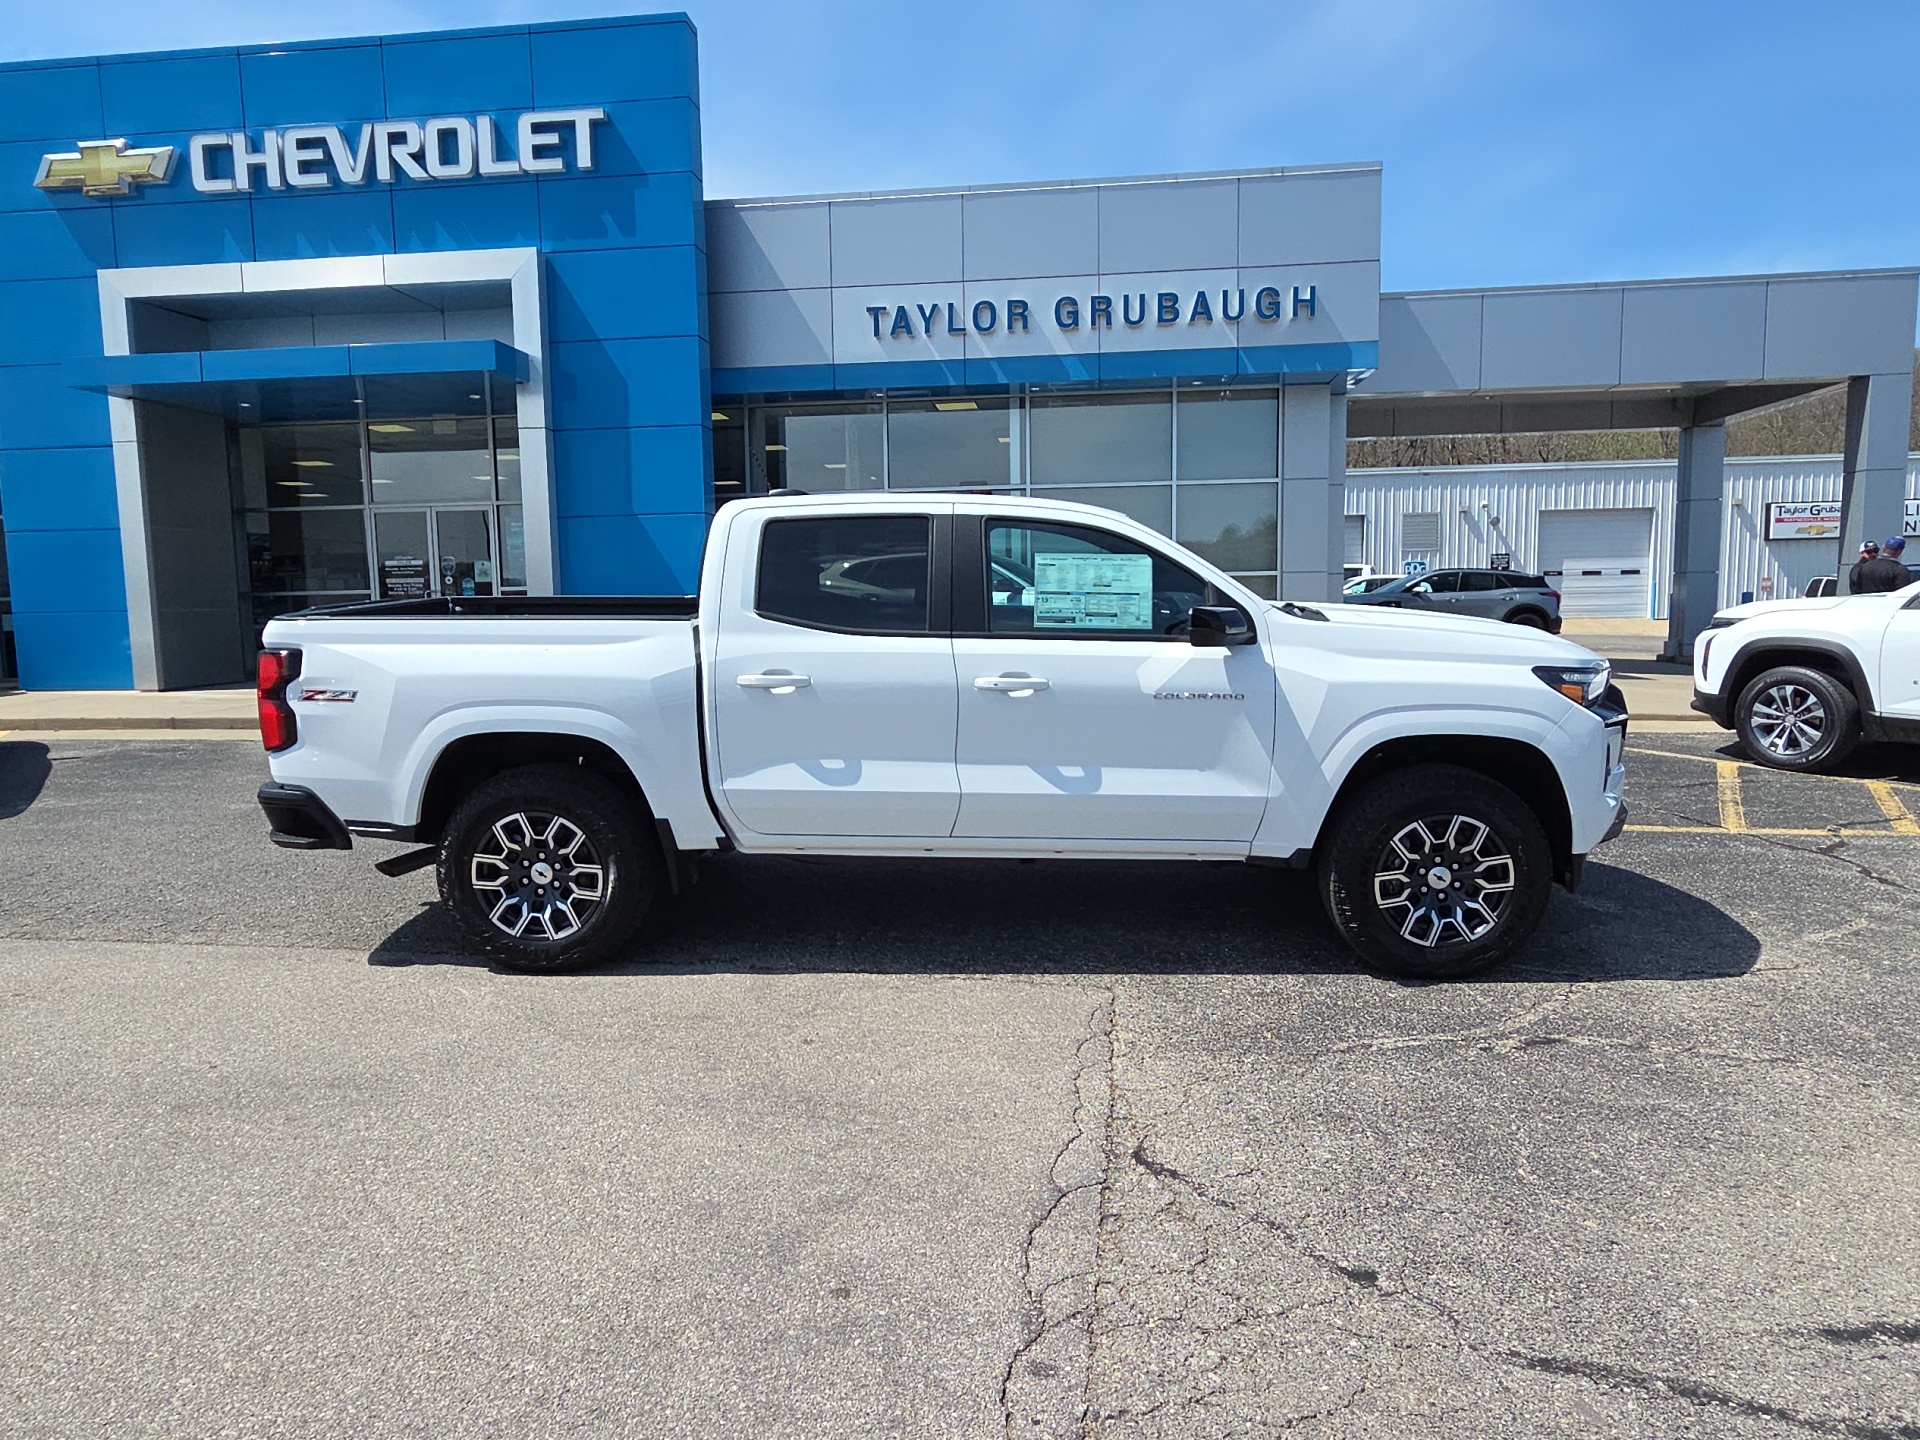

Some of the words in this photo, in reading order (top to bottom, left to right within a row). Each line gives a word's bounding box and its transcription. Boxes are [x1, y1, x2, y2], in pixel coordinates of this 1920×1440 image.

[188, 107, 608, 194] CHEVROLET
[865, 298, 1031, 340] TAYLOR
[1054, 284, 1318, 331] GRUBAUGH
[1776, 505, 1808, 517] Taylor
[1904, 519, 1920, 533] N
[298, 688, 358, 703] Z71
[1153, 693, 1245, 701] COLORADO
